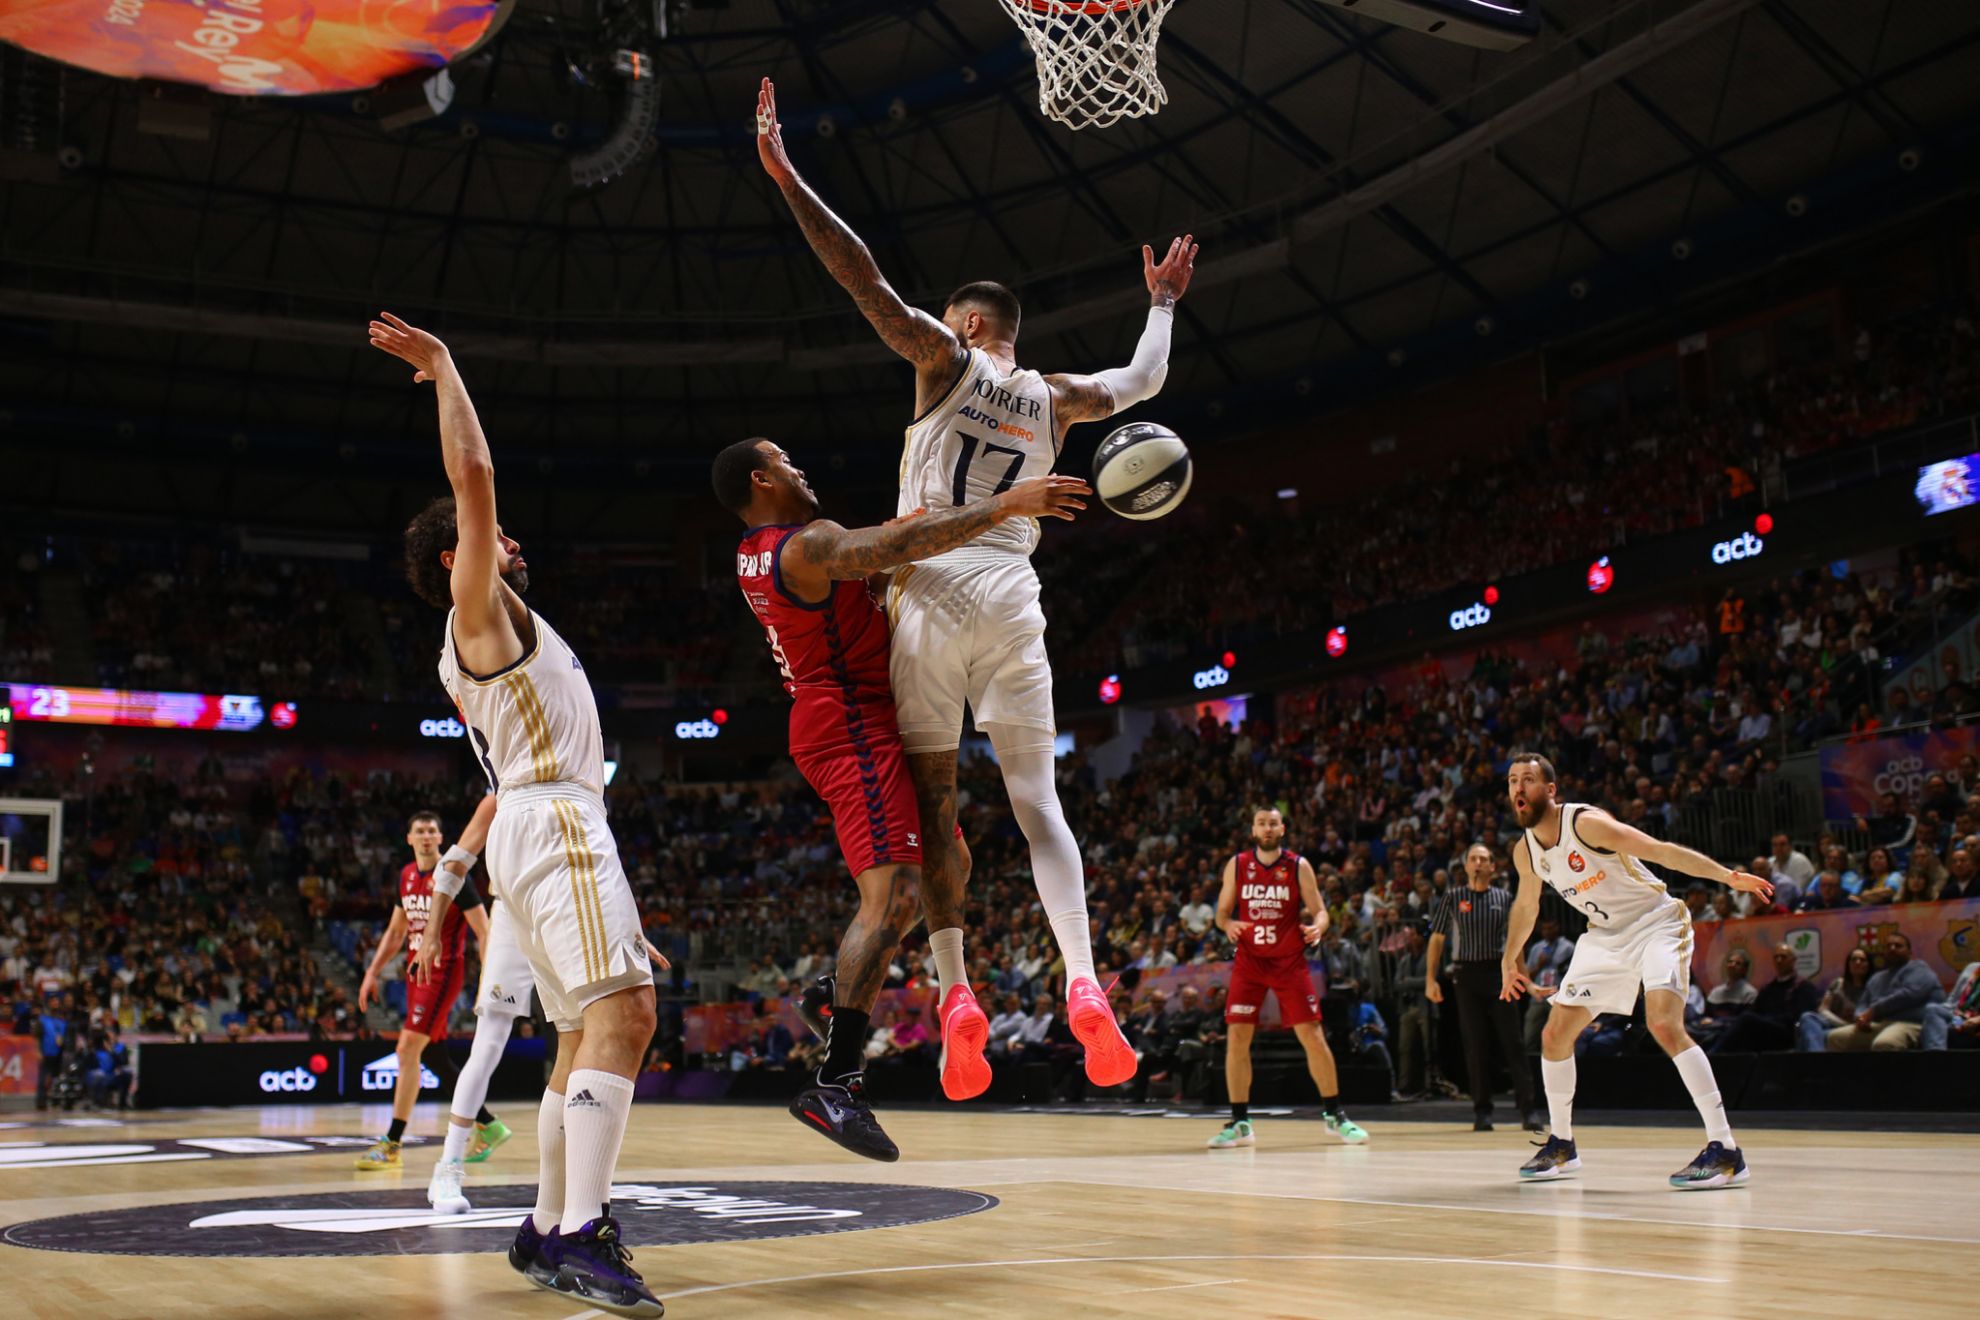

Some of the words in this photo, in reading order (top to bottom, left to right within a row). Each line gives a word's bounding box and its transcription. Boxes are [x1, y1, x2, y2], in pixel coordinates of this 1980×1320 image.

[176, 9, 263, 64] Rey
[958, 405, 1035, 442] AUTOHERO
[953, 430, 1026, 507] 17
[1711, 531, 1763, 564] acb
[1450, 601, 1491, 630] acb
[1193, 664, 1229, 689] acb
[30, 688, 70, 717] 23
[419, 717, 465, 737] acb
[675, 718, 719, 739] acb
[1241, 884, 1290, 901] UCAM
[1254, 925, 1277, 945] 25
[259, 1066, 317, 1092] acb
